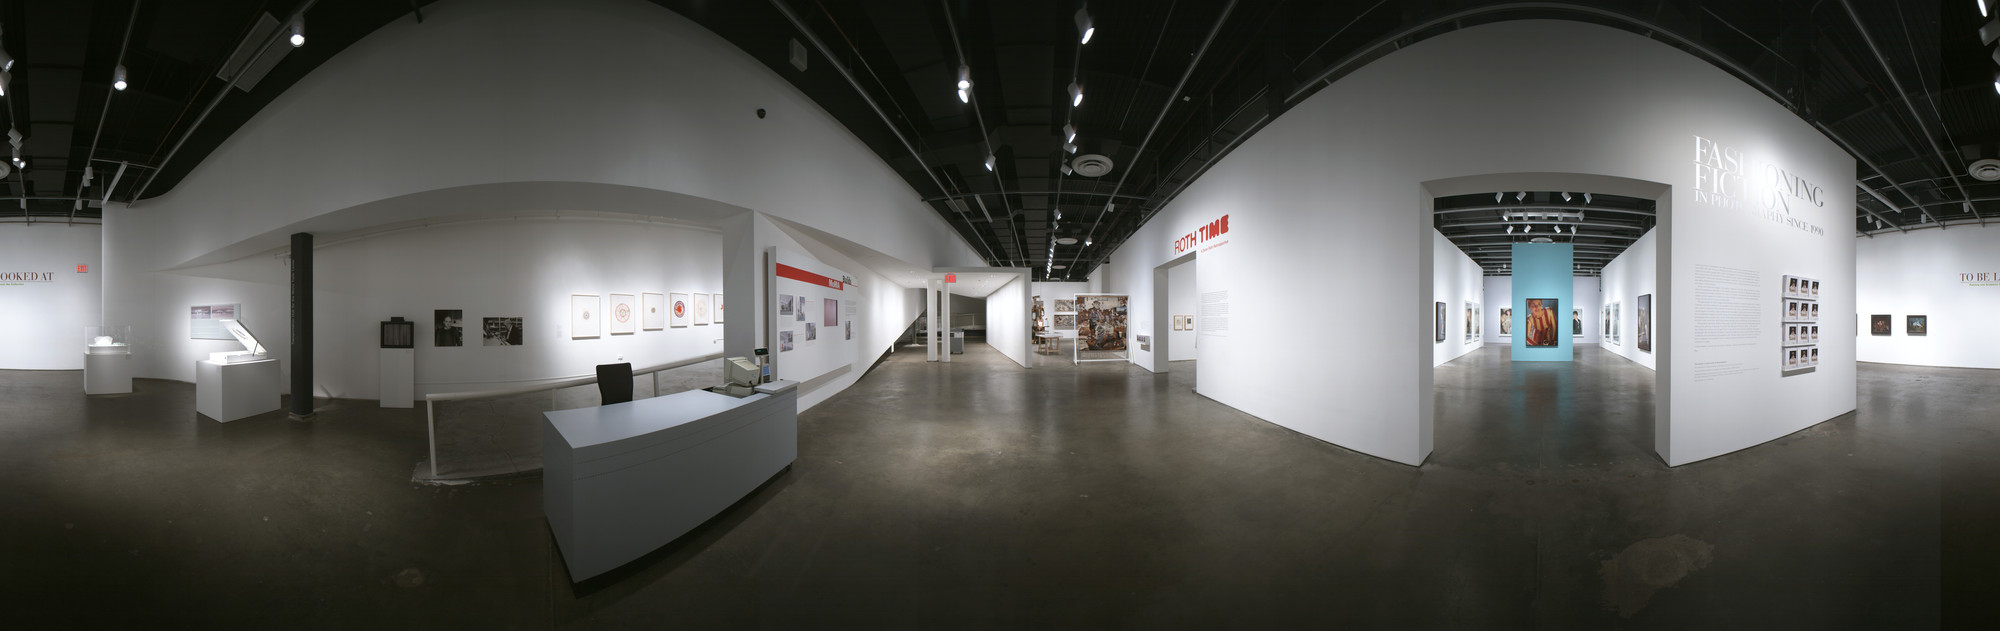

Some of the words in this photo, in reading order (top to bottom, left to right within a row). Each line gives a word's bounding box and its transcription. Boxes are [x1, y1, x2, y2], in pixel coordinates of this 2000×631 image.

[1693, 135, 1824, 207] FASONING
[1693, 162, 1791, 215] FICTON
[1174, 230, 1197, 255] ROTH
[1198, 213, 1229, 243] TIME
[1694, 190, 1707, 202] IN
[1711, 194, 1785, 224] PHOTRAPHY
[1786, 217, 1809, 232] SINCE
[1810, 224, 1824, 236] 1990
[0, 271, 38, 281] OOKED
[40, 271, 54, 281] AT
[945, 274, 956, 283] EXIT
[1959, 272, 1974, 281] TO
[1977, 272, 1990, 281] BE
